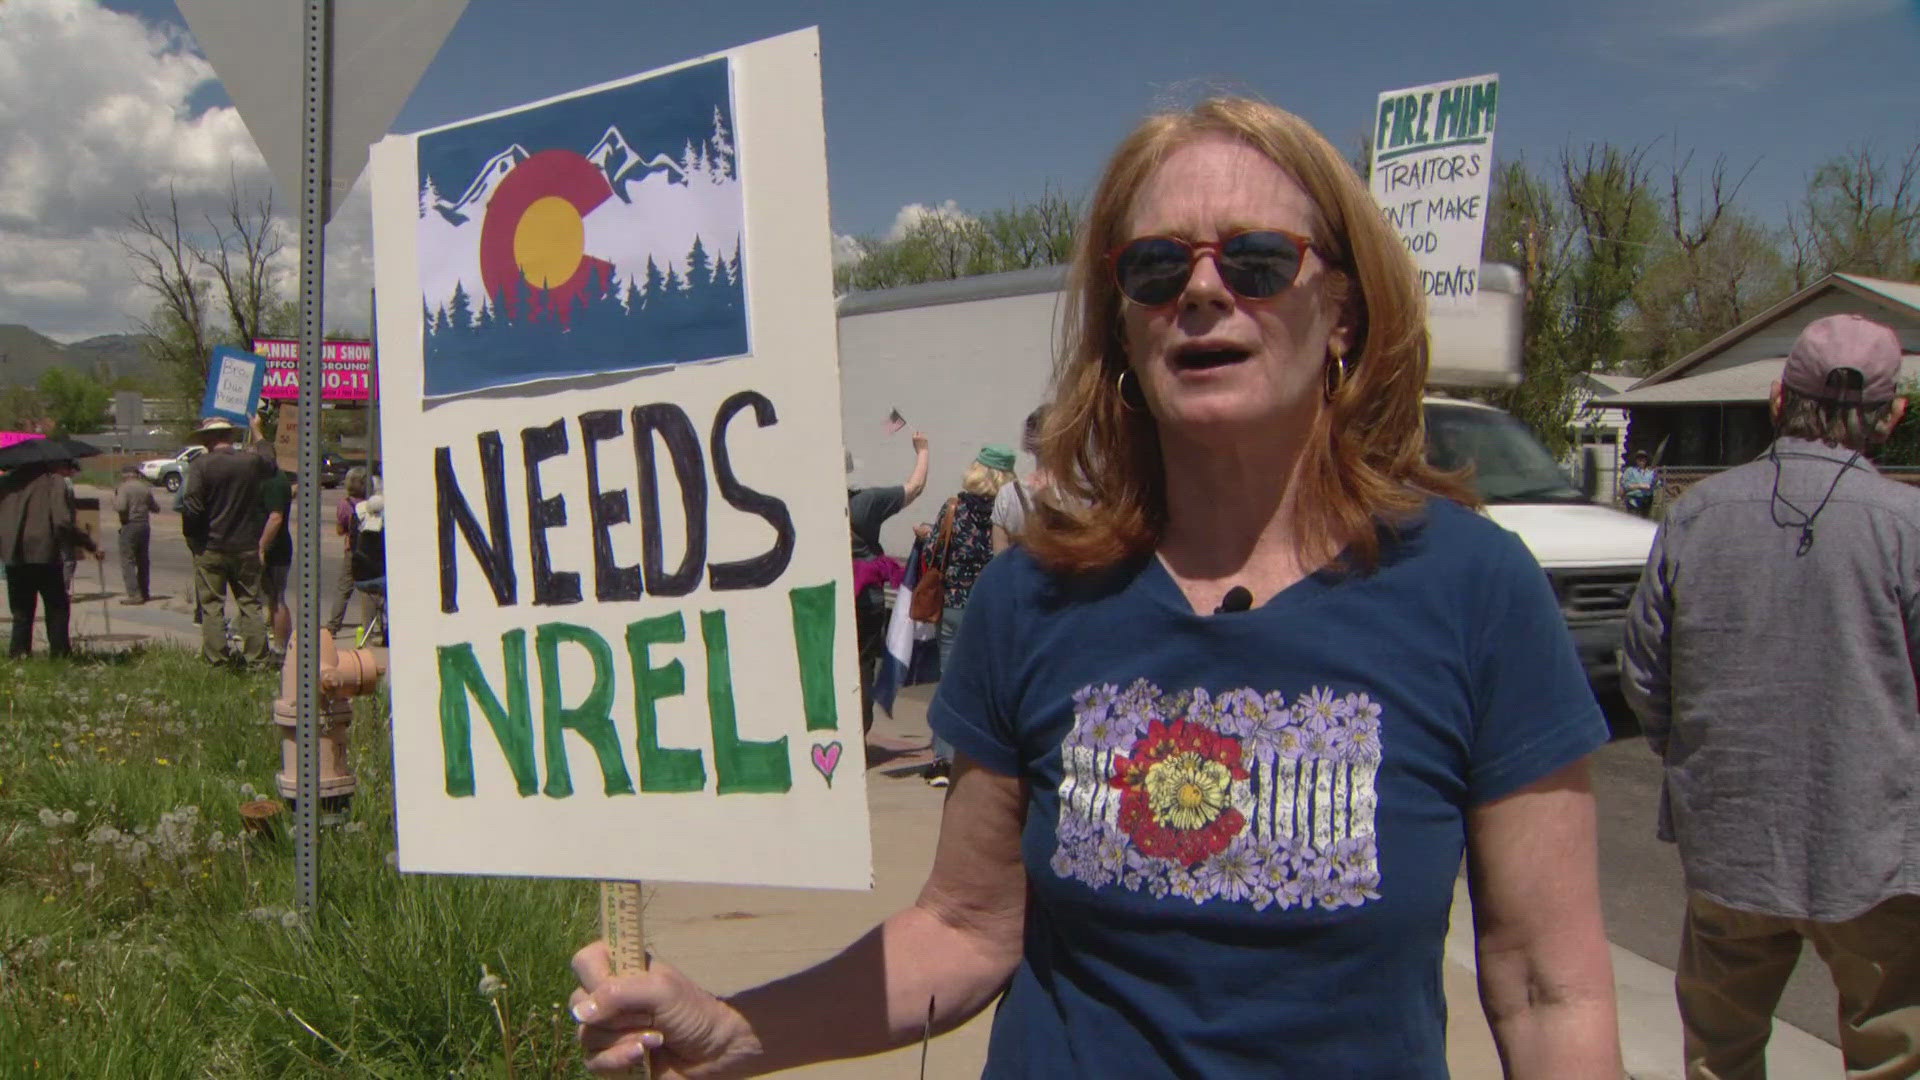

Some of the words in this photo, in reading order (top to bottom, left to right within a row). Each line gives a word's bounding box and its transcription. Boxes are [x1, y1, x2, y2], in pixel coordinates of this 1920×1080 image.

[1377, 93, 1434, 150] FIRE
[1435, 81, 1498, 140] HIM
[1377, 153, 1480, 193] TRAITORS
[1382, 199, 1422, 229] ON'T
[1427, 195, 1480, 223] MAKE
[1403, 231, 1437, 253] OOD
[263, 371, 299, 387] MA
[265, 360, 296, 369] EFFCO
[435, 390, 796, 613] NEEDS
[436, 580, 843, 798] NREL!
